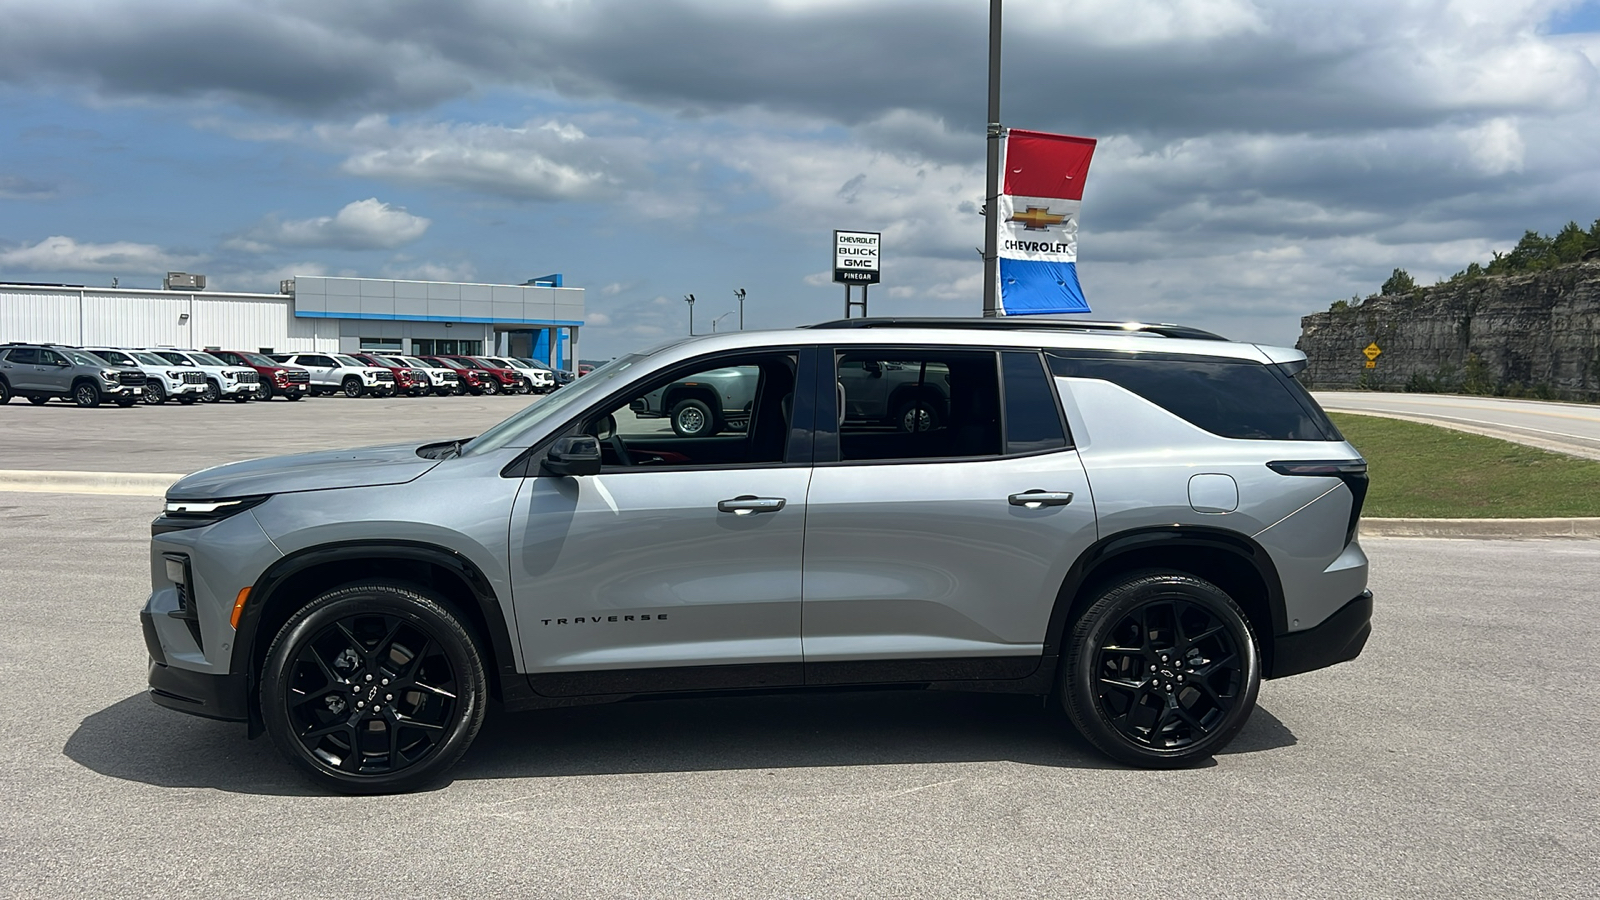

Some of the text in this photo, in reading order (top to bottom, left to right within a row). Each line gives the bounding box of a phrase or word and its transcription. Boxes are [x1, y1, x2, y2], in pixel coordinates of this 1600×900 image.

[839, 236, 877, 244] CHEVROLET
[838, 247, 877, 256] BUICK
[844, 259, 872, 267] GMC
[844, 272, 872, 280] PINEGAR
[540, 614, 668, 626] TRAVERSE
